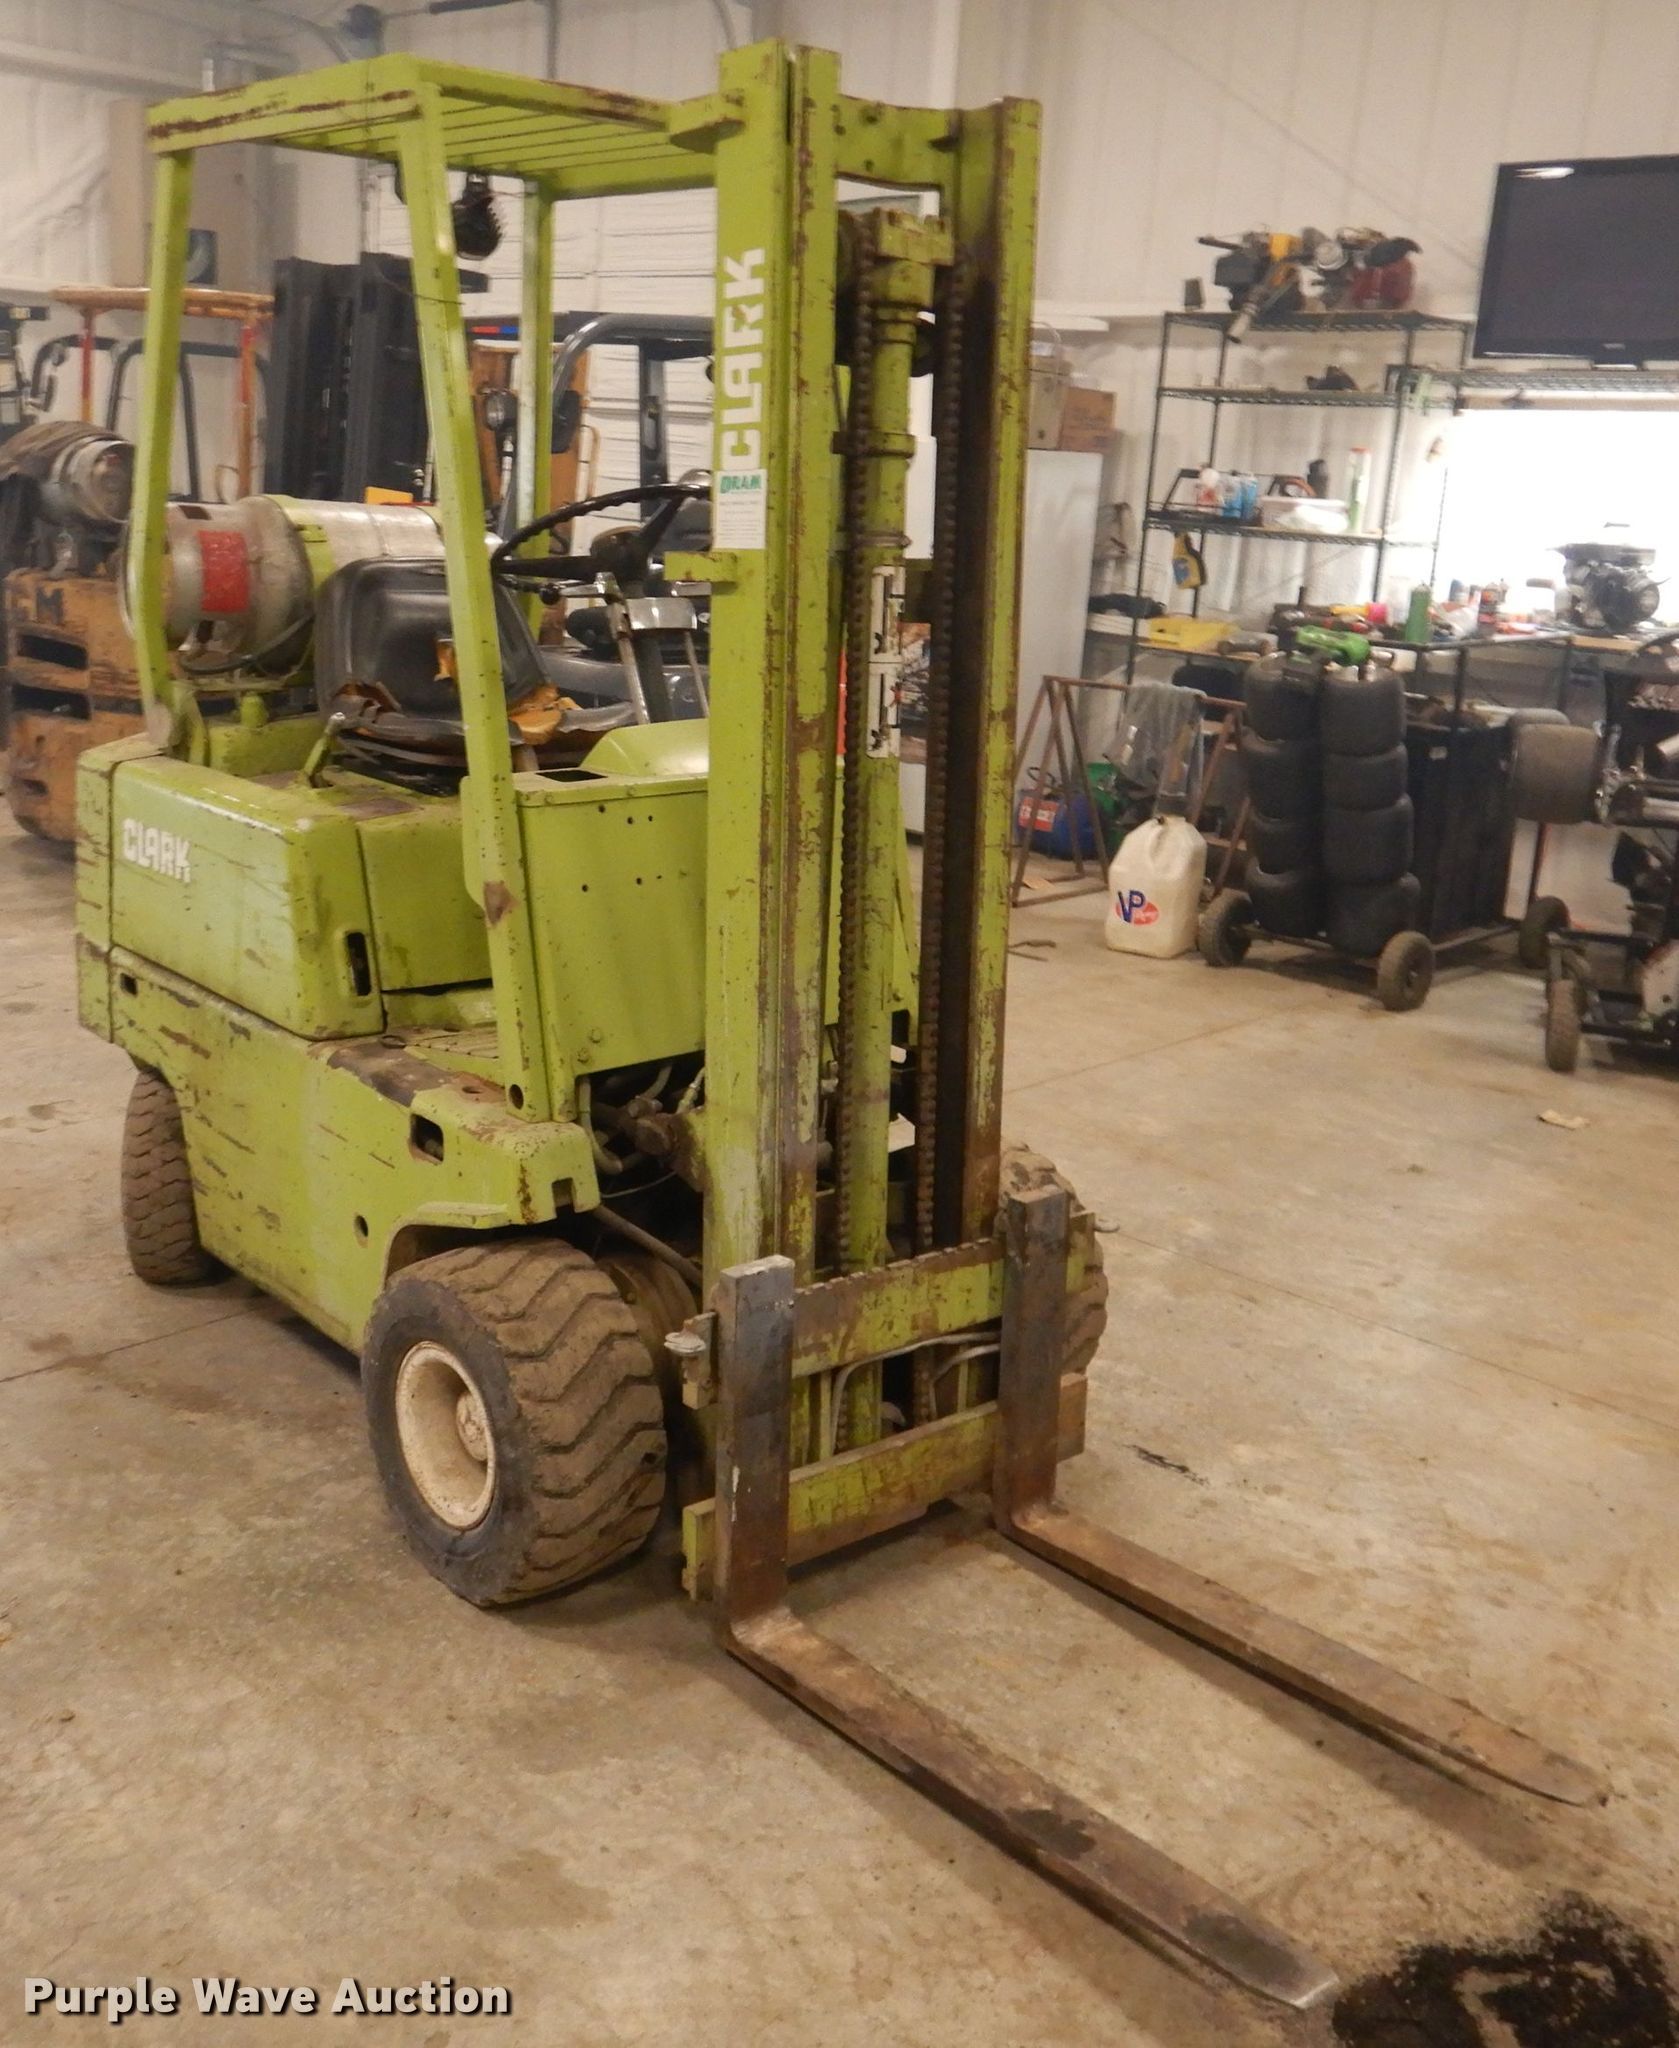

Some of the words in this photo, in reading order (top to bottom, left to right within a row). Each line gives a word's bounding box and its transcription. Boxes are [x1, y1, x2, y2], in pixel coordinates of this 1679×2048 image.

[720, 248, 765, 472] CLARK
[122, 818, 191, 883] CLARK
[1117, 890, 1145, 923] VP
